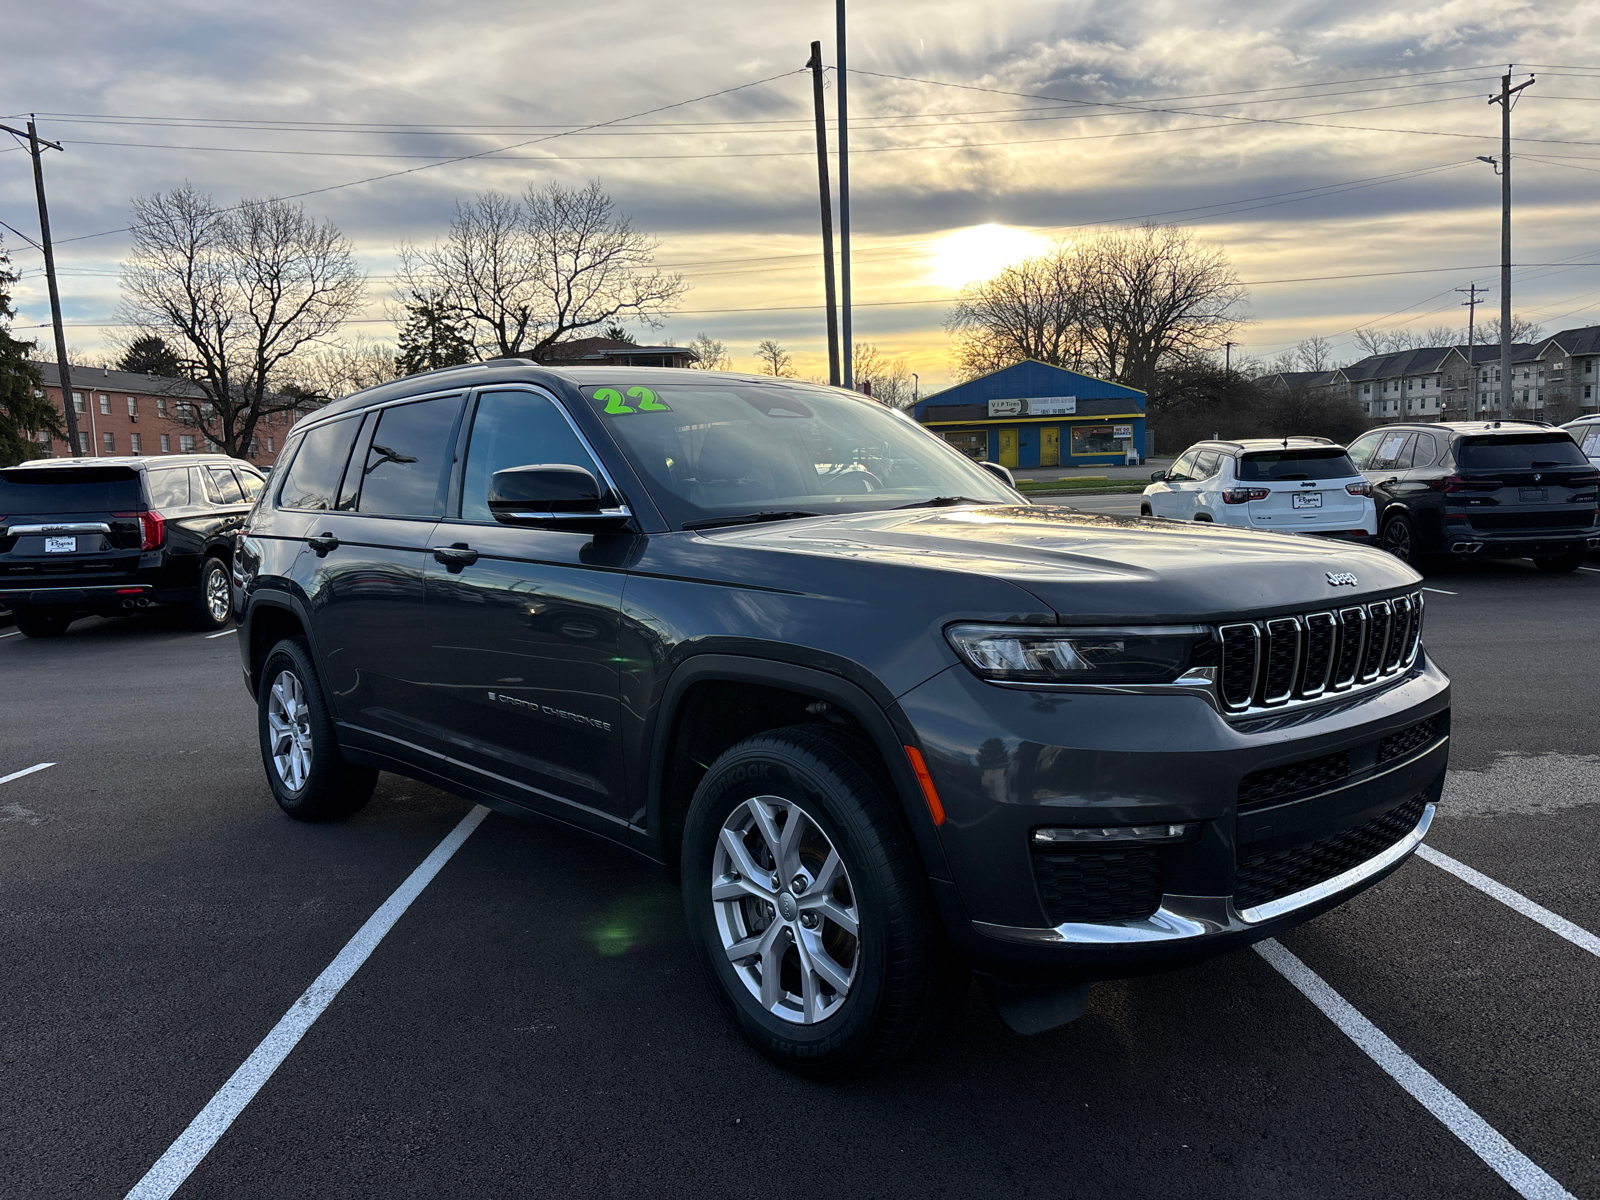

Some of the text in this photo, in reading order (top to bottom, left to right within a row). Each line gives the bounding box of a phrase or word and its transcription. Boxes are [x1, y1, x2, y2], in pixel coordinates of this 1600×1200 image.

[593, 386, 671, 414] 22
[1325, 571, 1358, 587] Jeep
[498, 694, 612, 732] GRAND CHEROKEE
